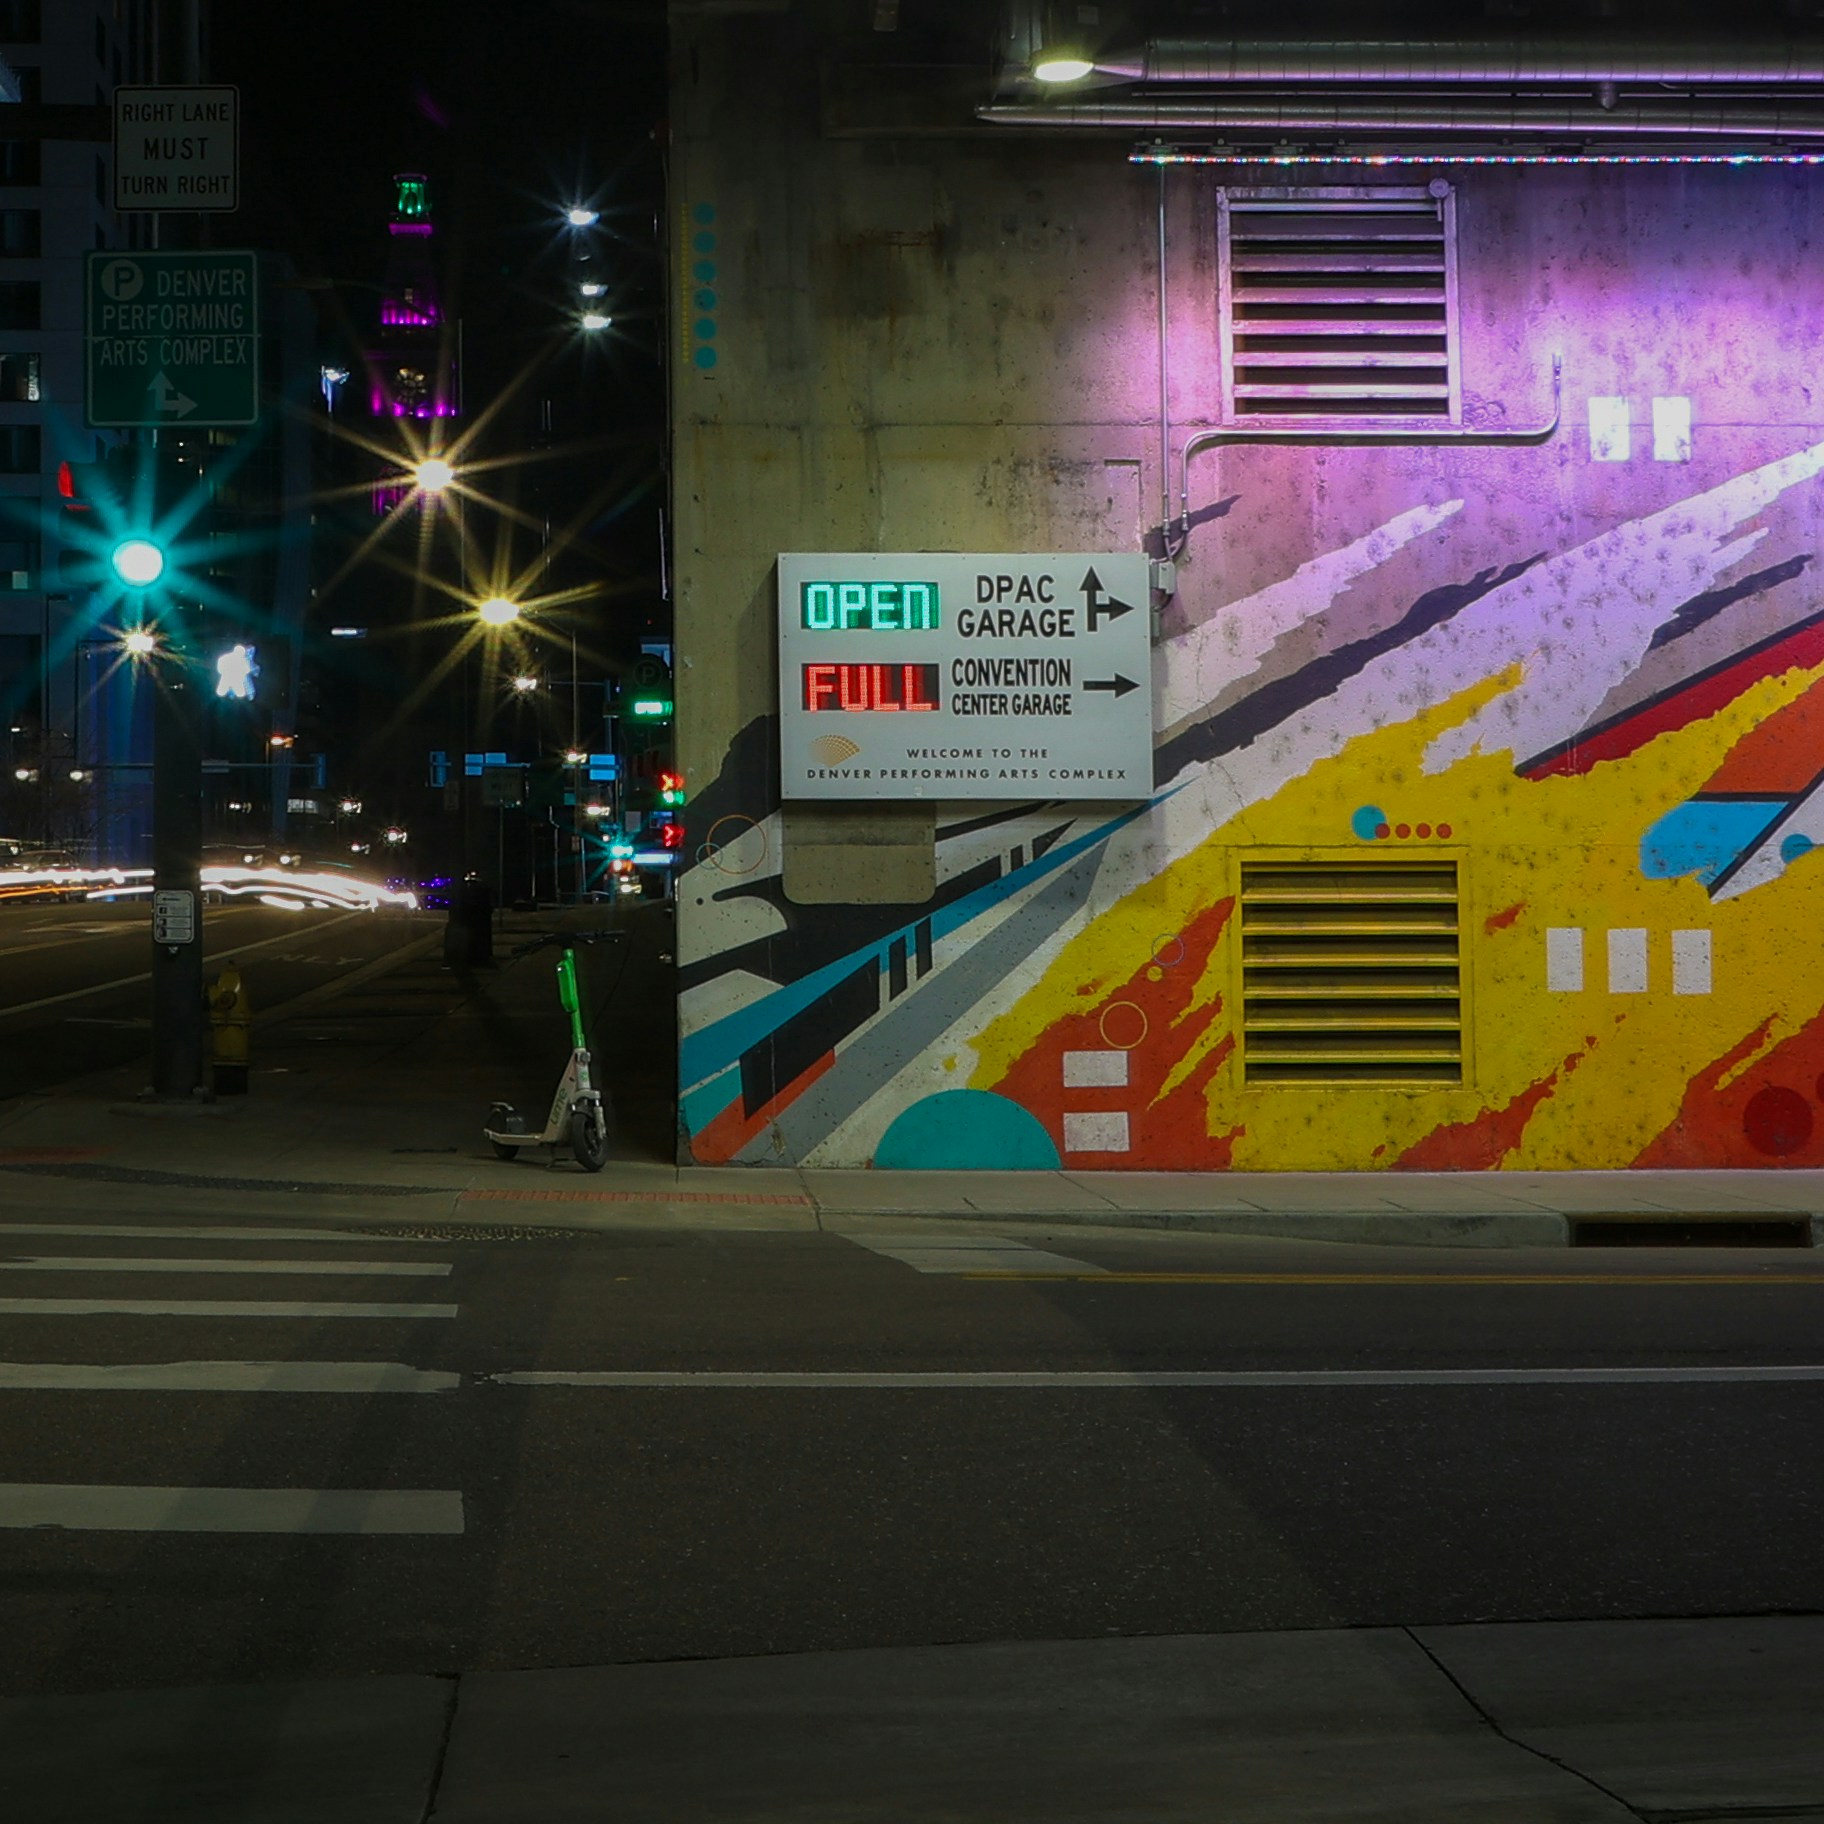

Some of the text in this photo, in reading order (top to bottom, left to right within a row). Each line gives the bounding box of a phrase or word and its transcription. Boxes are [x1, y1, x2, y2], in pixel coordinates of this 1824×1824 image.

[122, 103, 229, 122] RIGHT LANE
[143, 136, 209, 161] MUST
[121, 176, 231, 195] TURN RIGHT
[157, 268, 246, 297] DENVER
[102, 303, 244, 330] PERFORMING
[100, 338, 246, 366] ARTS COMPLEX
[976, 574, 1055, 604] DPAC
[806, 583, 931, 629] OPEN
[957, 608, 1076, 638] GARAGE
[951, 658, 1072, 687] CONVENTION
[808, 666, 933, 712] FULL
[951, 693, 1072, 716] CENTER GARAGE
[906, 748, 1048, 759] WELCOME TO THE
[807, 769, 1126, 780] DENVER PERFORMING ARTS COMPLEX
